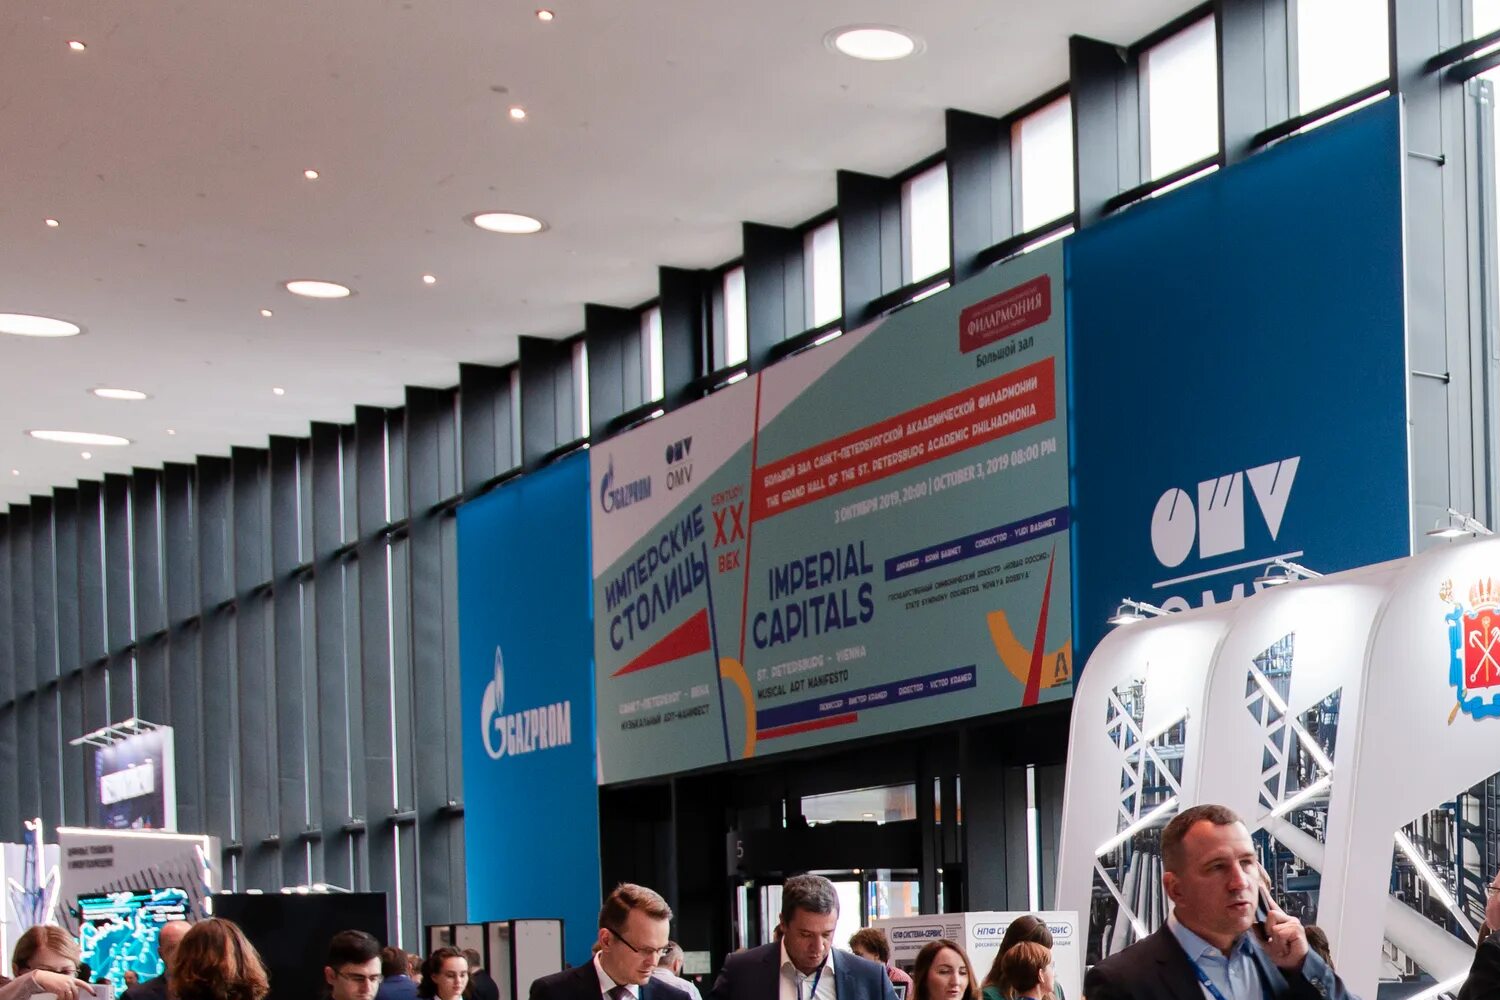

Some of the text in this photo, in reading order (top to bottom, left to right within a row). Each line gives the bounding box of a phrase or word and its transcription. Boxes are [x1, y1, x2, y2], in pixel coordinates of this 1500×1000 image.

[967, 293, 1042, 336] ФИЛАРМОНИЯ
[976, 336, 1034, 368] Большой зал
[797, 460, 812, 476] ЗАЛ
[906, 398, 975, 435] АКАДЕМИЧЕСКОЙ
[978, 376, 1038, 409] ФИЛАРМОНИИ
[666, 464, 693, 491] OMV
[766, 403, 1037, 508] THE GRAND HALL OF THE ST. PETERSBURG ACADEMIC PHILHARMONIA
[834, 509, 840, 524] 3
[840, 497, 879, 522] ОКТЯБРЯ
[903, 481, 927, 502] 20:00
[933, 466, 975, 492] OCTOBER
[986, 455, 1009, 476] 2019
[1010, 444, 1039, 467] 08:00
[1041, 437, 1057, 456] PM
[605, 504, 705, 612] ИМПЕРСКИЕ
[718, 551, 741, 575] ВЕК
[768, 540, 874, 601] IMPERIAL
[610, 545, 709, 651] СТОЛИЦЫ
[753, 582, 874, 649] CAPITALS
[757, 669, 849, 700] MUSICAL ART MANIFESTO
[506, 700, 571, 756] GAZPROM
[977, 927, 996, 936] НПФ
